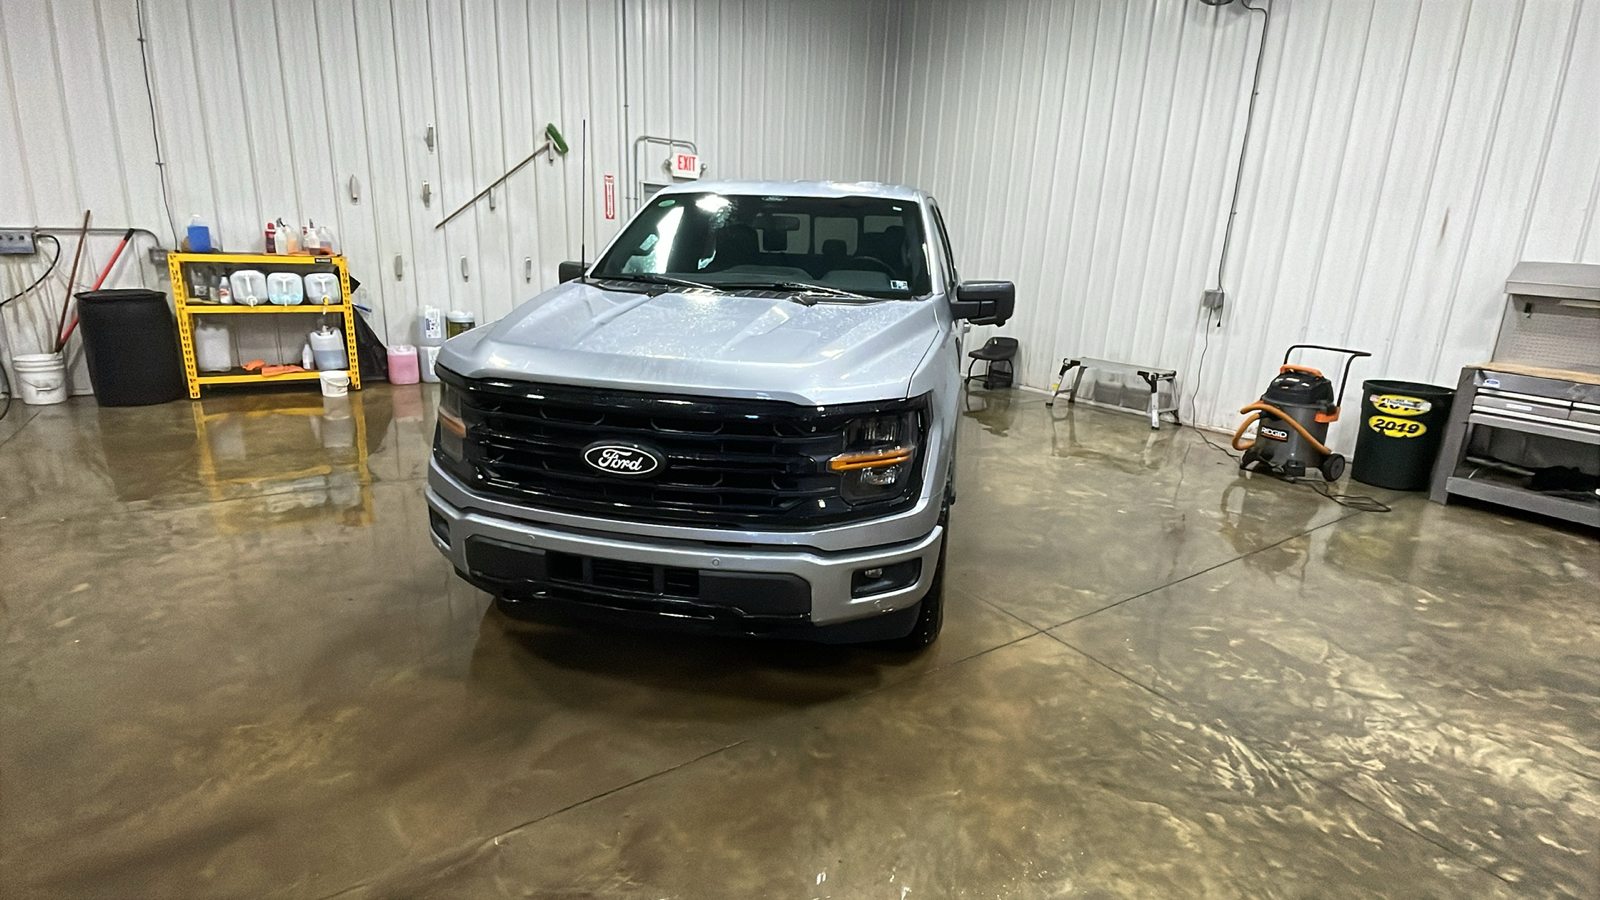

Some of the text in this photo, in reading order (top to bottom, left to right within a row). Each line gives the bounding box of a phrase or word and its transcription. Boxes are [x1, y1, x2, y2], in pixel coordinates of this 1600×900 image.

[678, 155, 696, 171] EXIT
[1261, 426, 1288, 438] RIDGID
[1374, 418, 1420, 434] 2019
[597, 448, 643, 471] Ford
